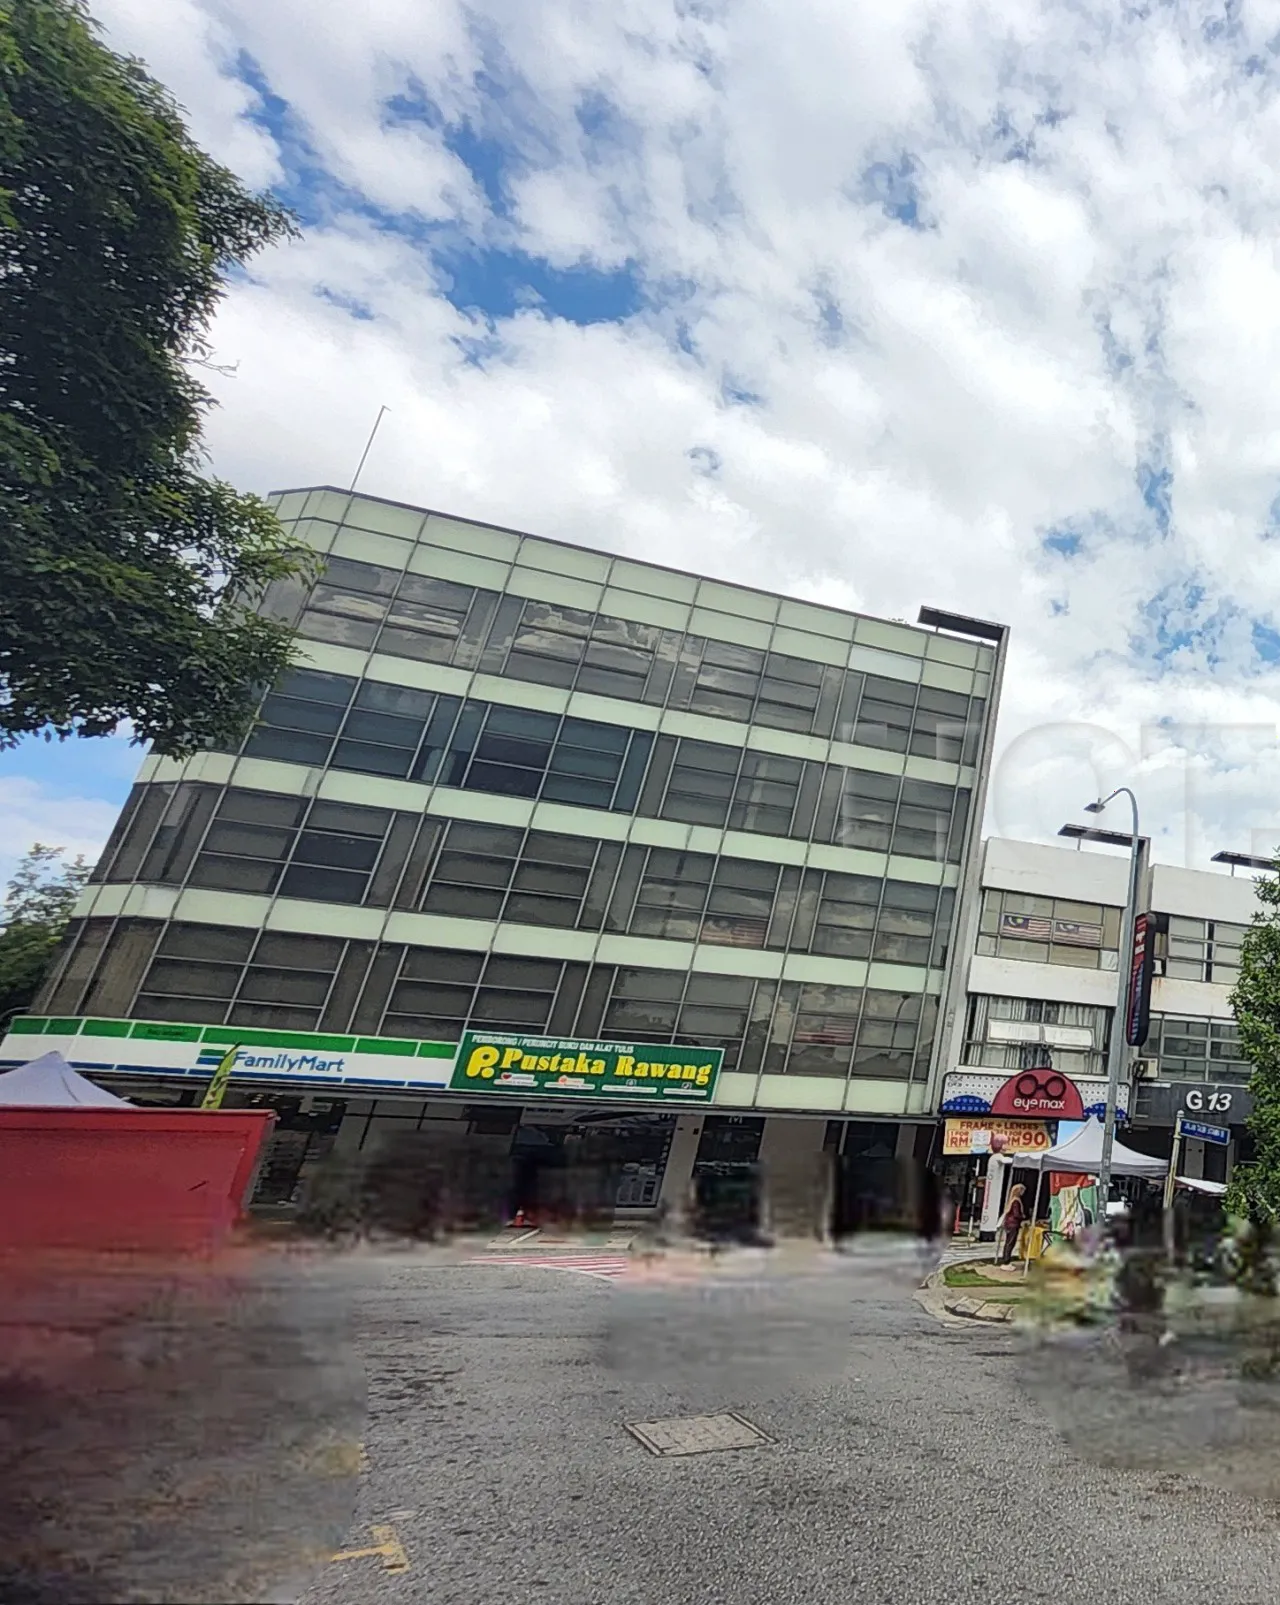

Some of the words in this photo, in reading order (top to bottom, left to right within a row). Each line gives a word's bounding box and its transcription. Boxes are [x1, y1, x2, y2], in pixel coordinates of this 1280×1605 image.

[595, 1044, 614, 1053] ALAT
[234, 1051, 345, 1072] FamilyMart
[500, 1047, 606, 1075] Pustaka
[614, 1055, 713, 1085] Rawang
[960, 1121, 993, 1130] FRAME
